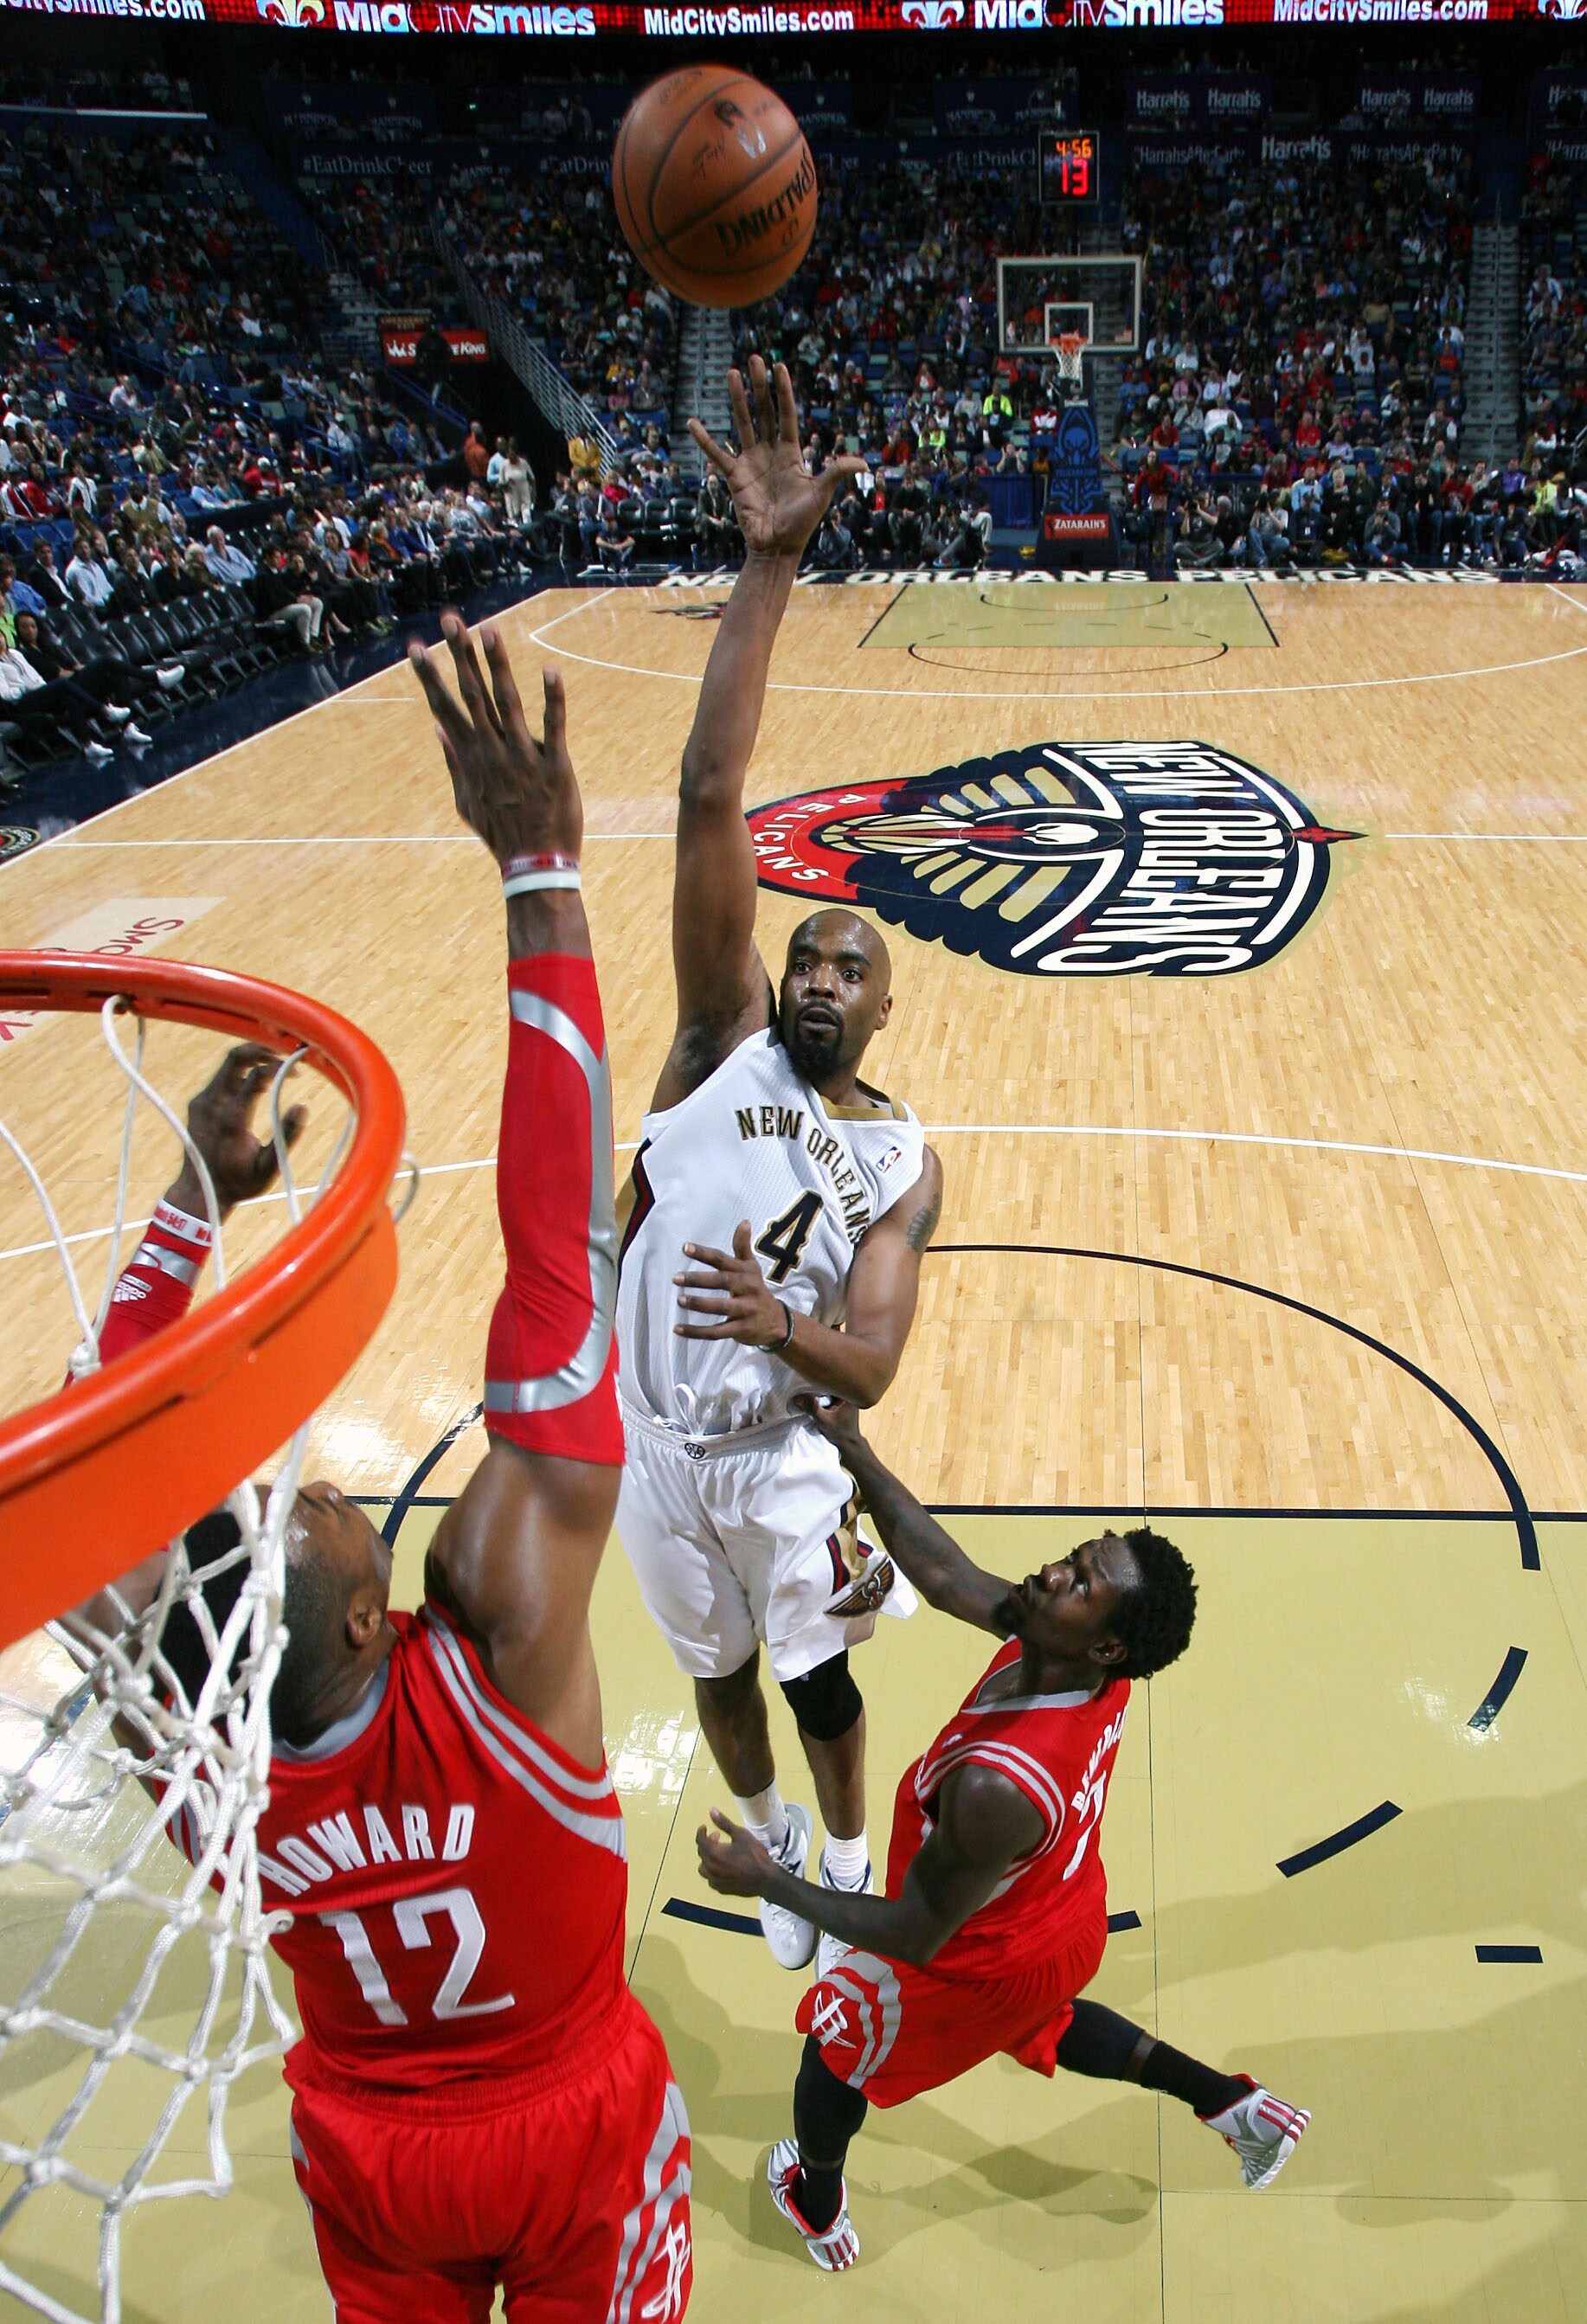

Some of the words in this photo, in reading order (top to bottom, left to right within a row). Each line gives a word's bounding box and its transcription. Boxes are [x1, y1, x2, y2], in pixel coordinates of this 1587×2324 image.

[643, 6, 854, 36] MidCitySmiles.com
[1273, 0, 1488, 22] MidCitySmiles.com
[1208, 87, 1261, 109] Harrah's
[1423, 87, 1475, 107] Harrah's
[1055, 137, 1092, 158] 4:56
[1061, 157, 1089, 196] 13
[845, 569, 1149, 584] ORLEANS
[1176, 569, 1500, 583] PELICANS
[1057, 741, 1259, 799] NEW
[751, 793, 867, 881] PELICANS
[1036, 808, 1286, 972] ORLEANS
[736, 1105, 805, 1141] NEW
[806, 1127, 872, 1246] ORLEANS
[754, 1189, 825, 1285] 4
[258, 1803, 475, 1897] HOWARD
[318, 1887, 517, 2026] 12
